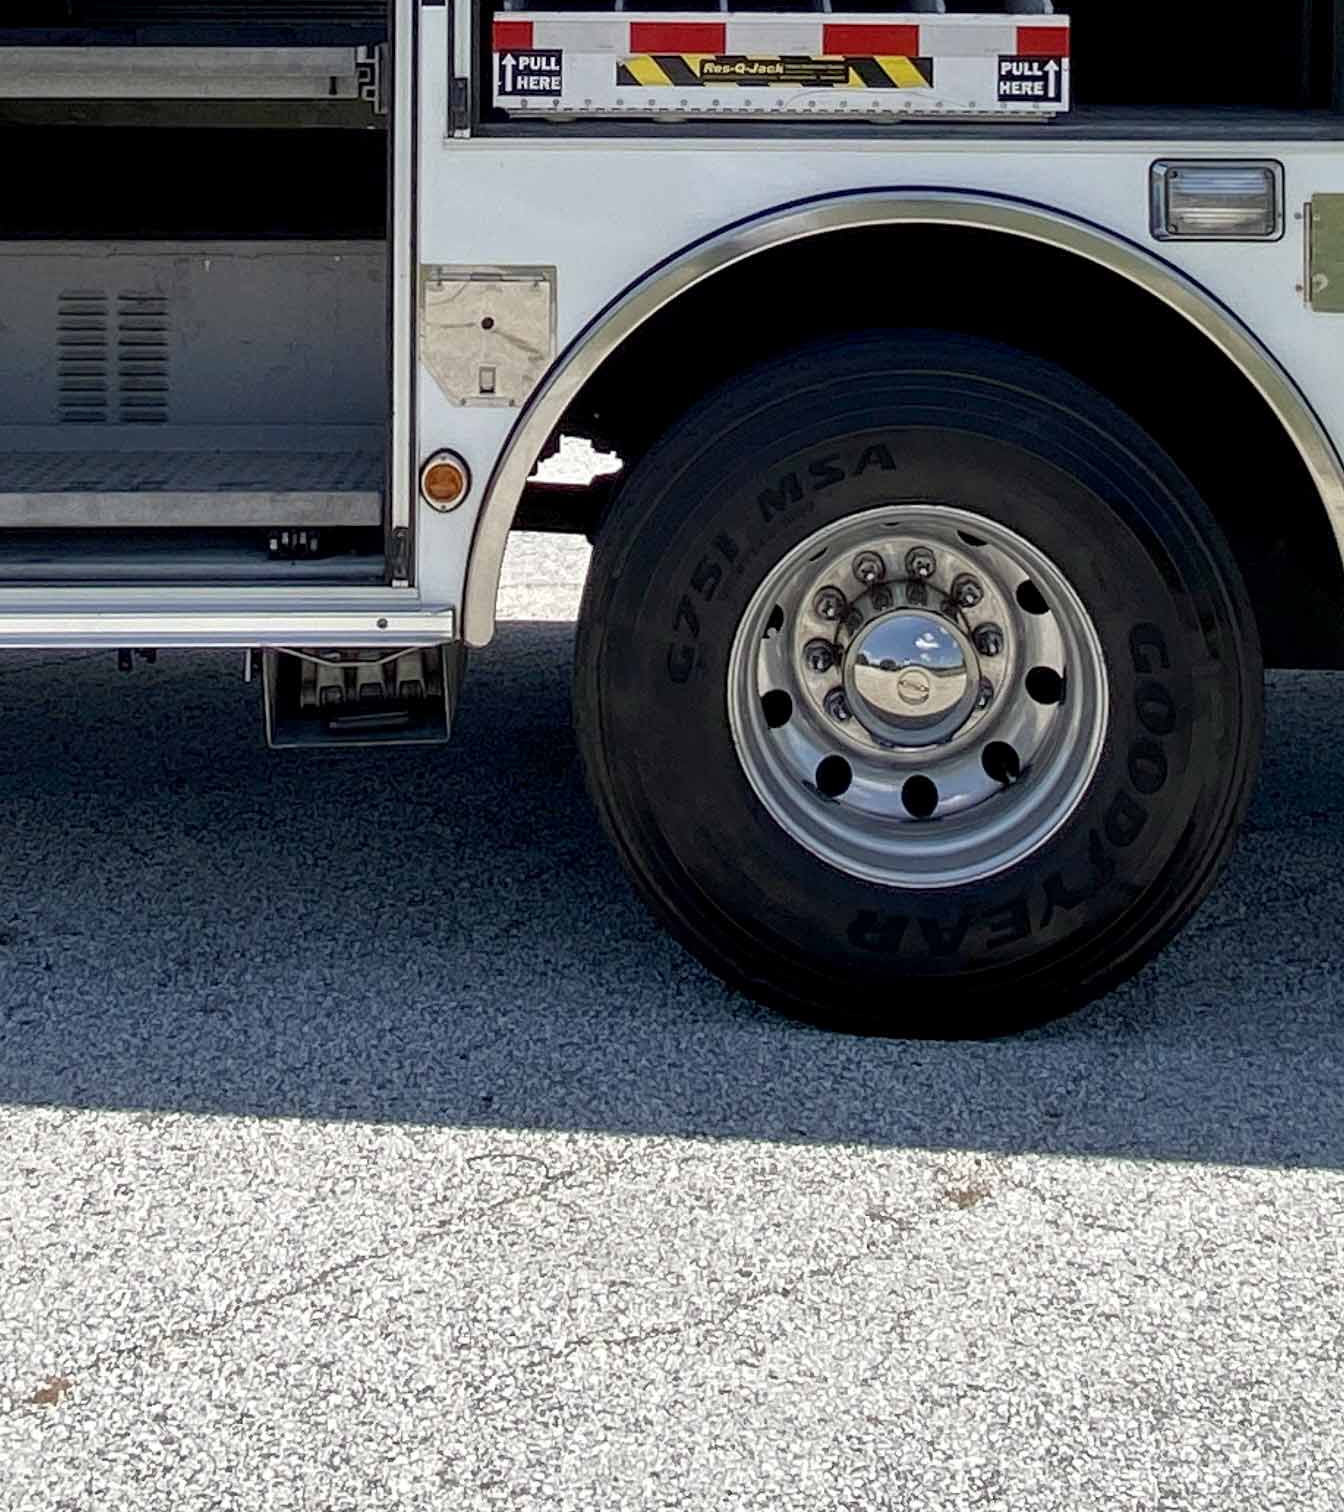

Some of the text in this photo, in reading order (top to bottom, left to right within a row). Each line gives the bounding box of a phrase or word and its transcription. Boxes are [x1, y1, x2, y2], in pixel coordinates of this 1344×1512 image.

[519, 56, 561, 71] PULL
[703, 62, 785, 75] Res-Q-Jack
[1000, 61, 1044, 76] PULL
[516, 76, 561, 91] HERE
[999, 80, 1045, 96] HERE
[757, 442, 897, 523] MSA
[846, 621, 1177, 957] GOODYEAR
